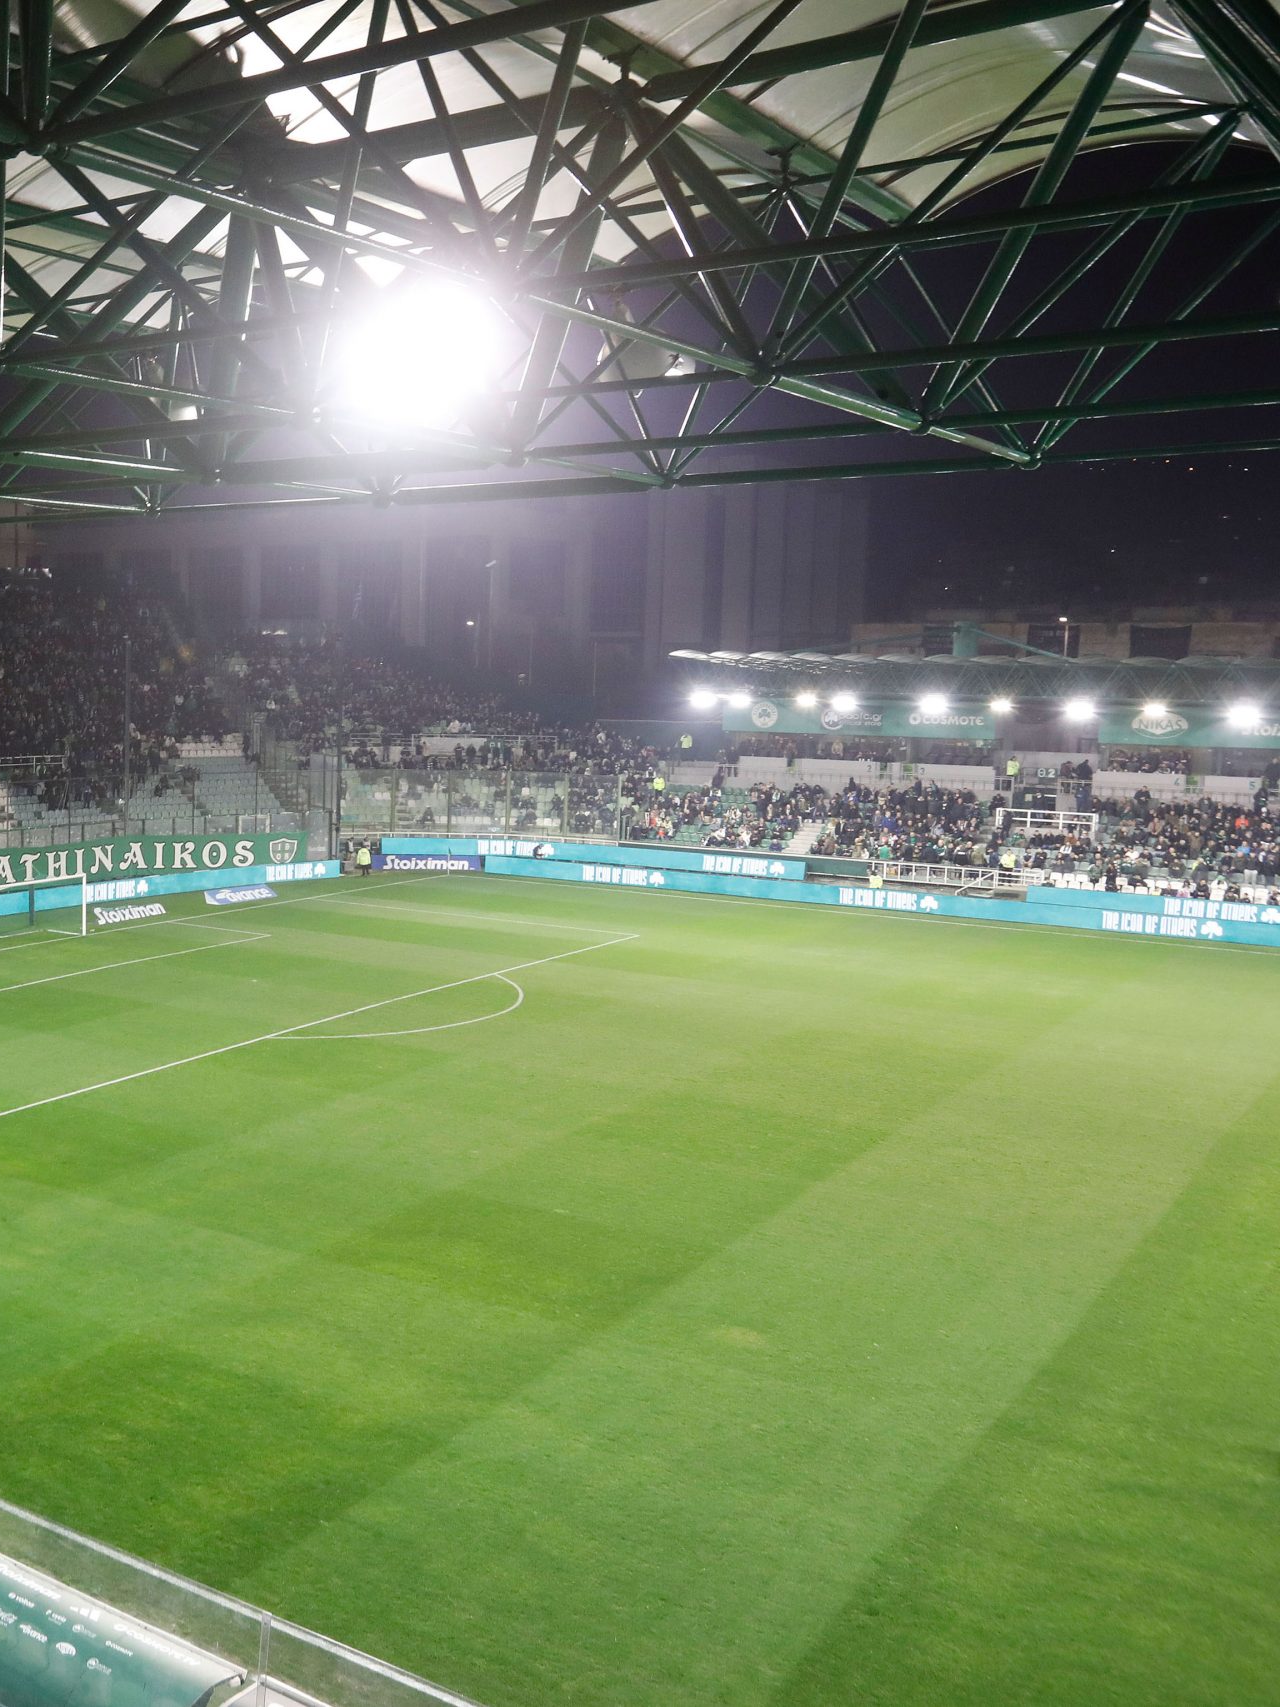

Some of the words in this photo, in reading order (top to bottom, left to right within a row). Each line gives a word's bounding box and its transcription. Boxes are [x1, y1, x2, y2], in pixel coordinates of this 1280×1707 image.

[922, 715, 985, 726] COSMOTE
[1138, 719, 1183, 730] NIKAS
[383, 855, 469, 870] Stoiximan
[94, 903, 166, 925] Stoiximan
